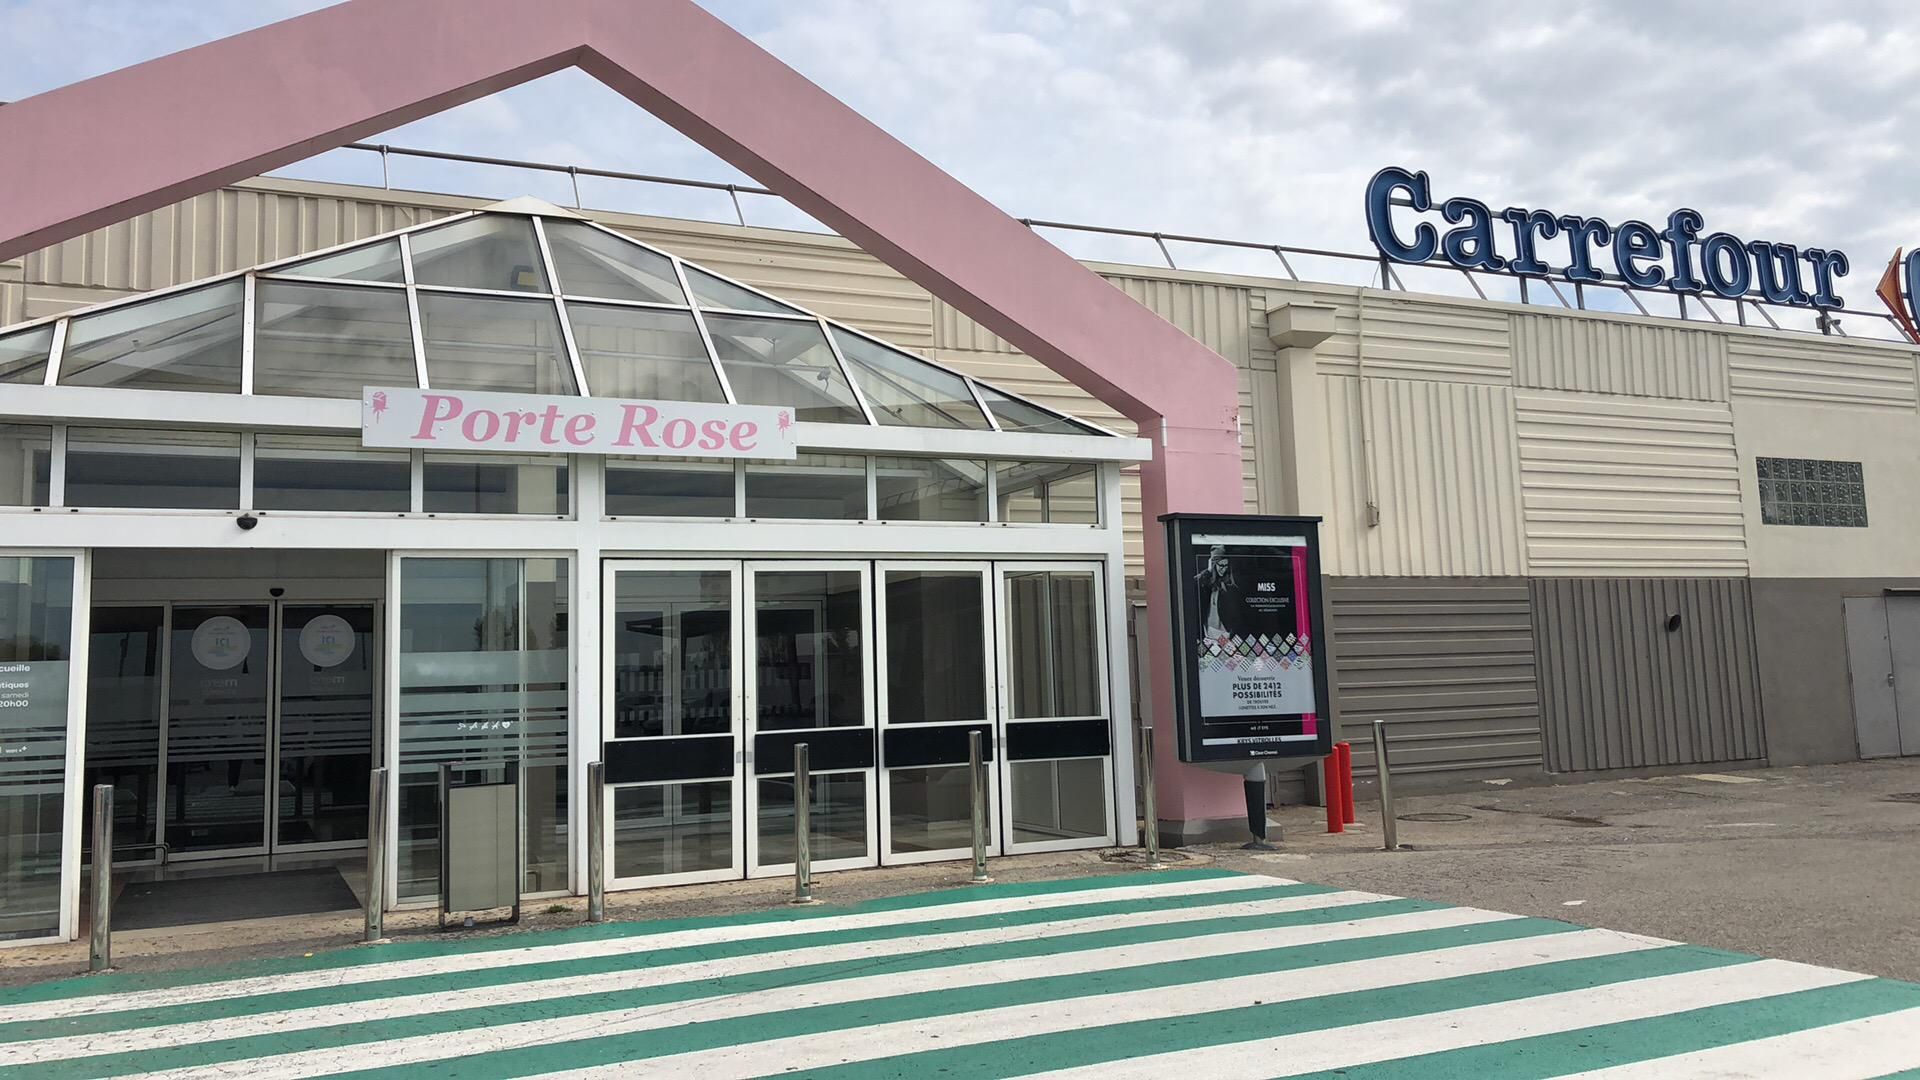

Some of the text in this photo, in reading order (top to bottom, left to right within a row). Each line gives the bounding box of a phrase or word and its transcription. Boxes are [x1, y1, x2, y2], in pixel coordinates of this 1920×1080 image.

[1365, 166, 1850, 310] Carrefour
[410, 394, 758, 451] Porte Rose
[1257, 582, 1276, 592] MISS
[1232, 689, 1282, 699] POSSIBILITÉS
